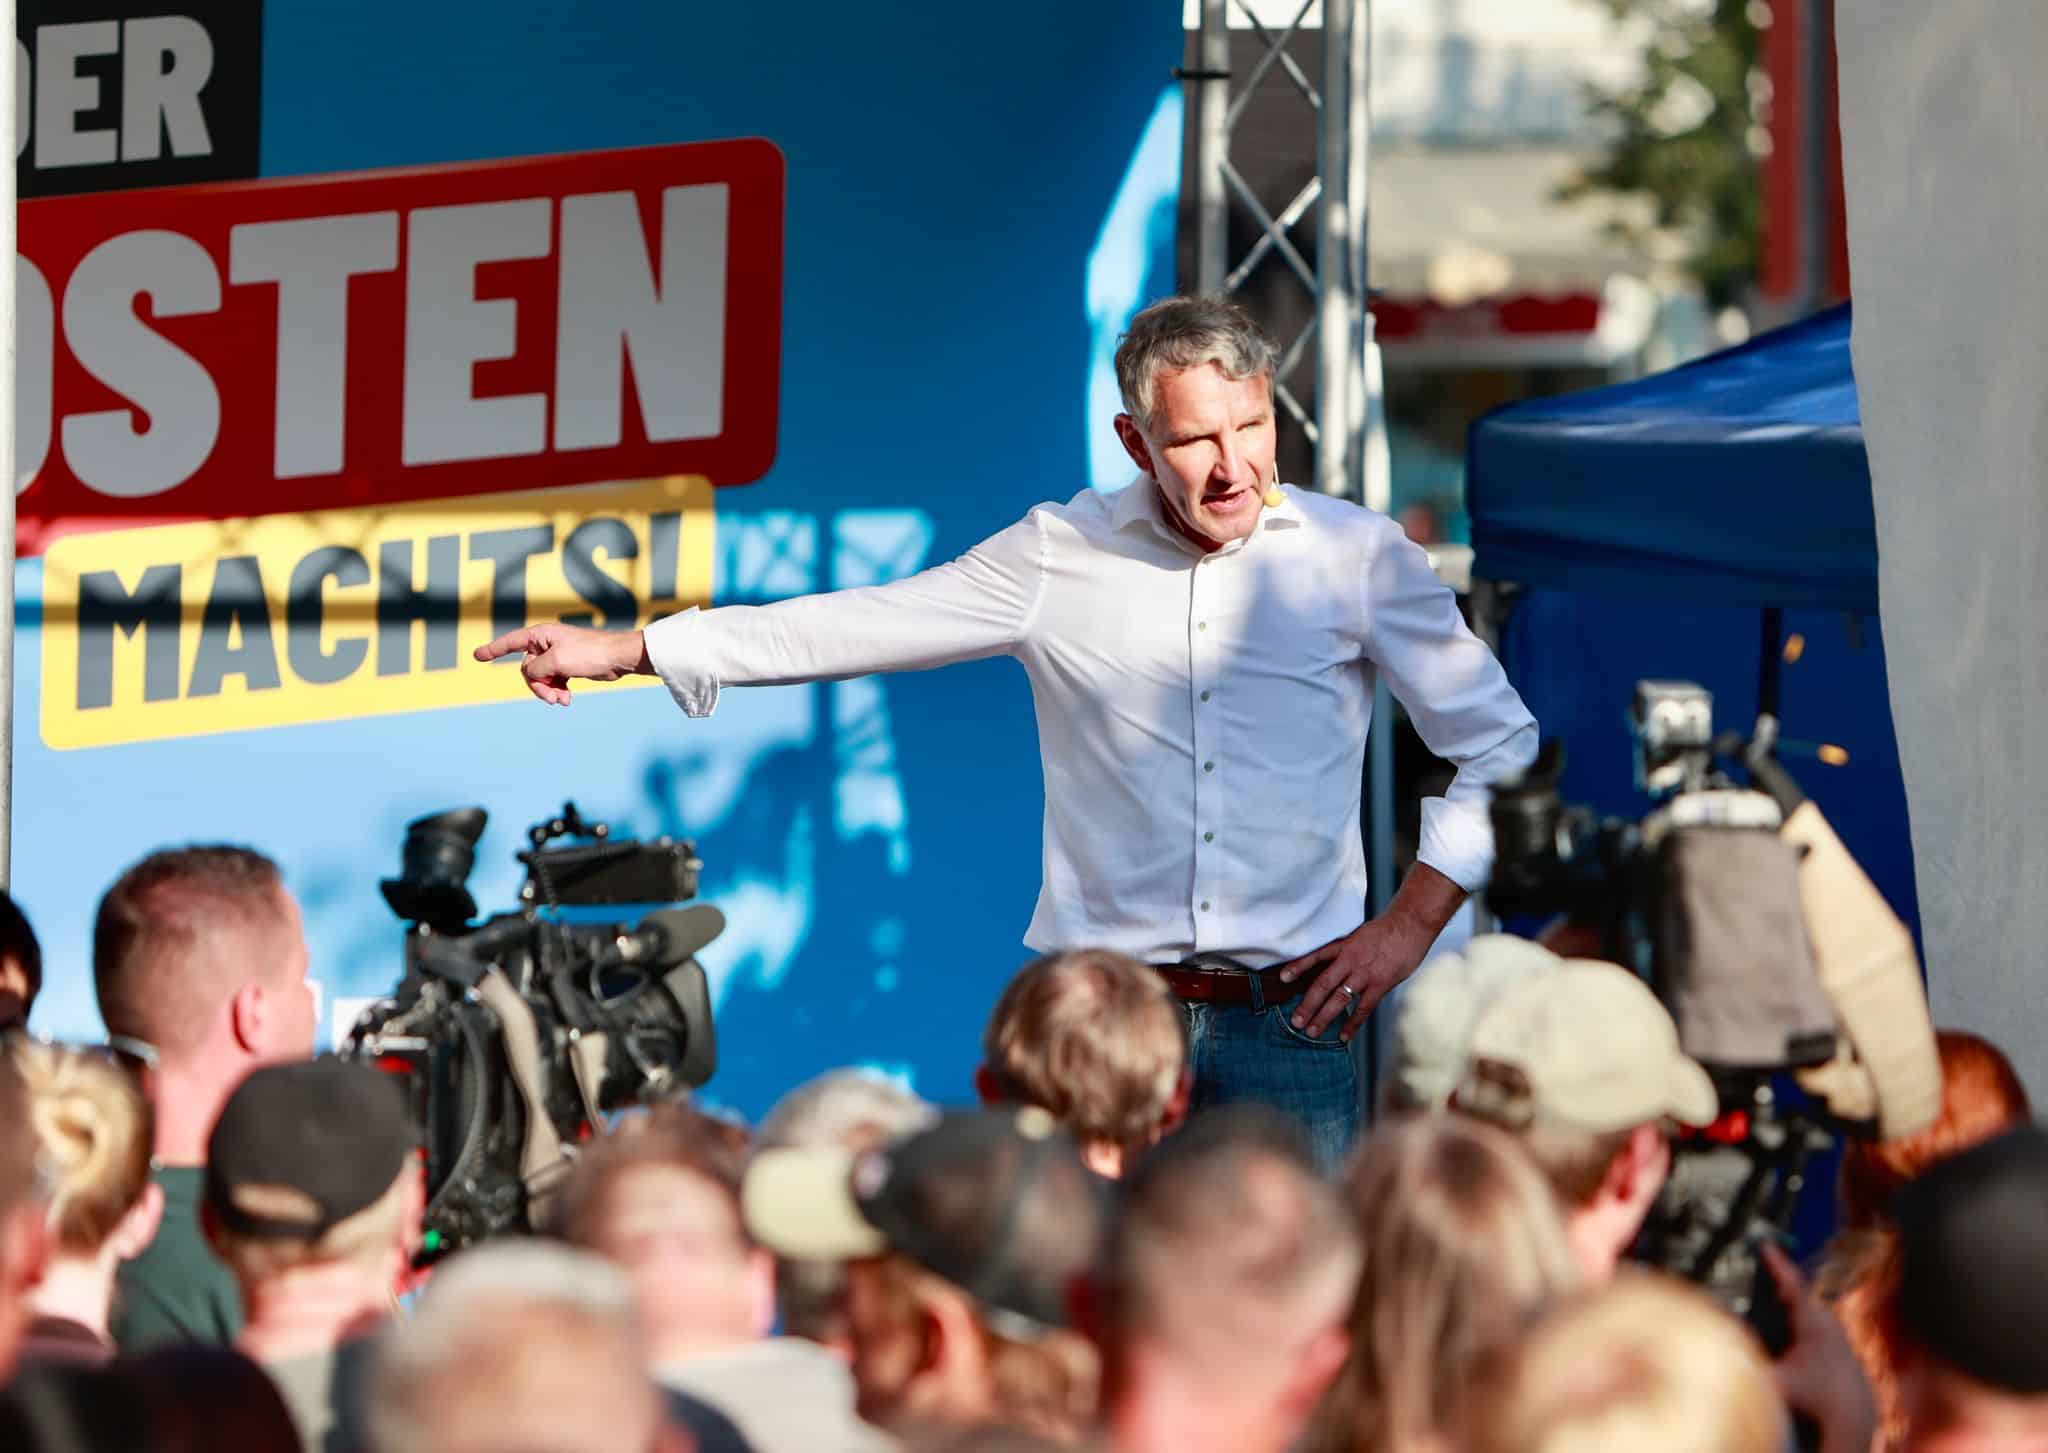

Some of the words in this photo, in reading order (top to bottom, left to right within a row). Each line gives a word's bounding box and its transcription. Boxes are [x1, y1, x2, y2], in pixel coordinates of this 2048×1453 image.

[17, 15, 214, 169] ER
[16, 182, 729, 498] STEN
[76, 511, 682, 711] MACHTS!
